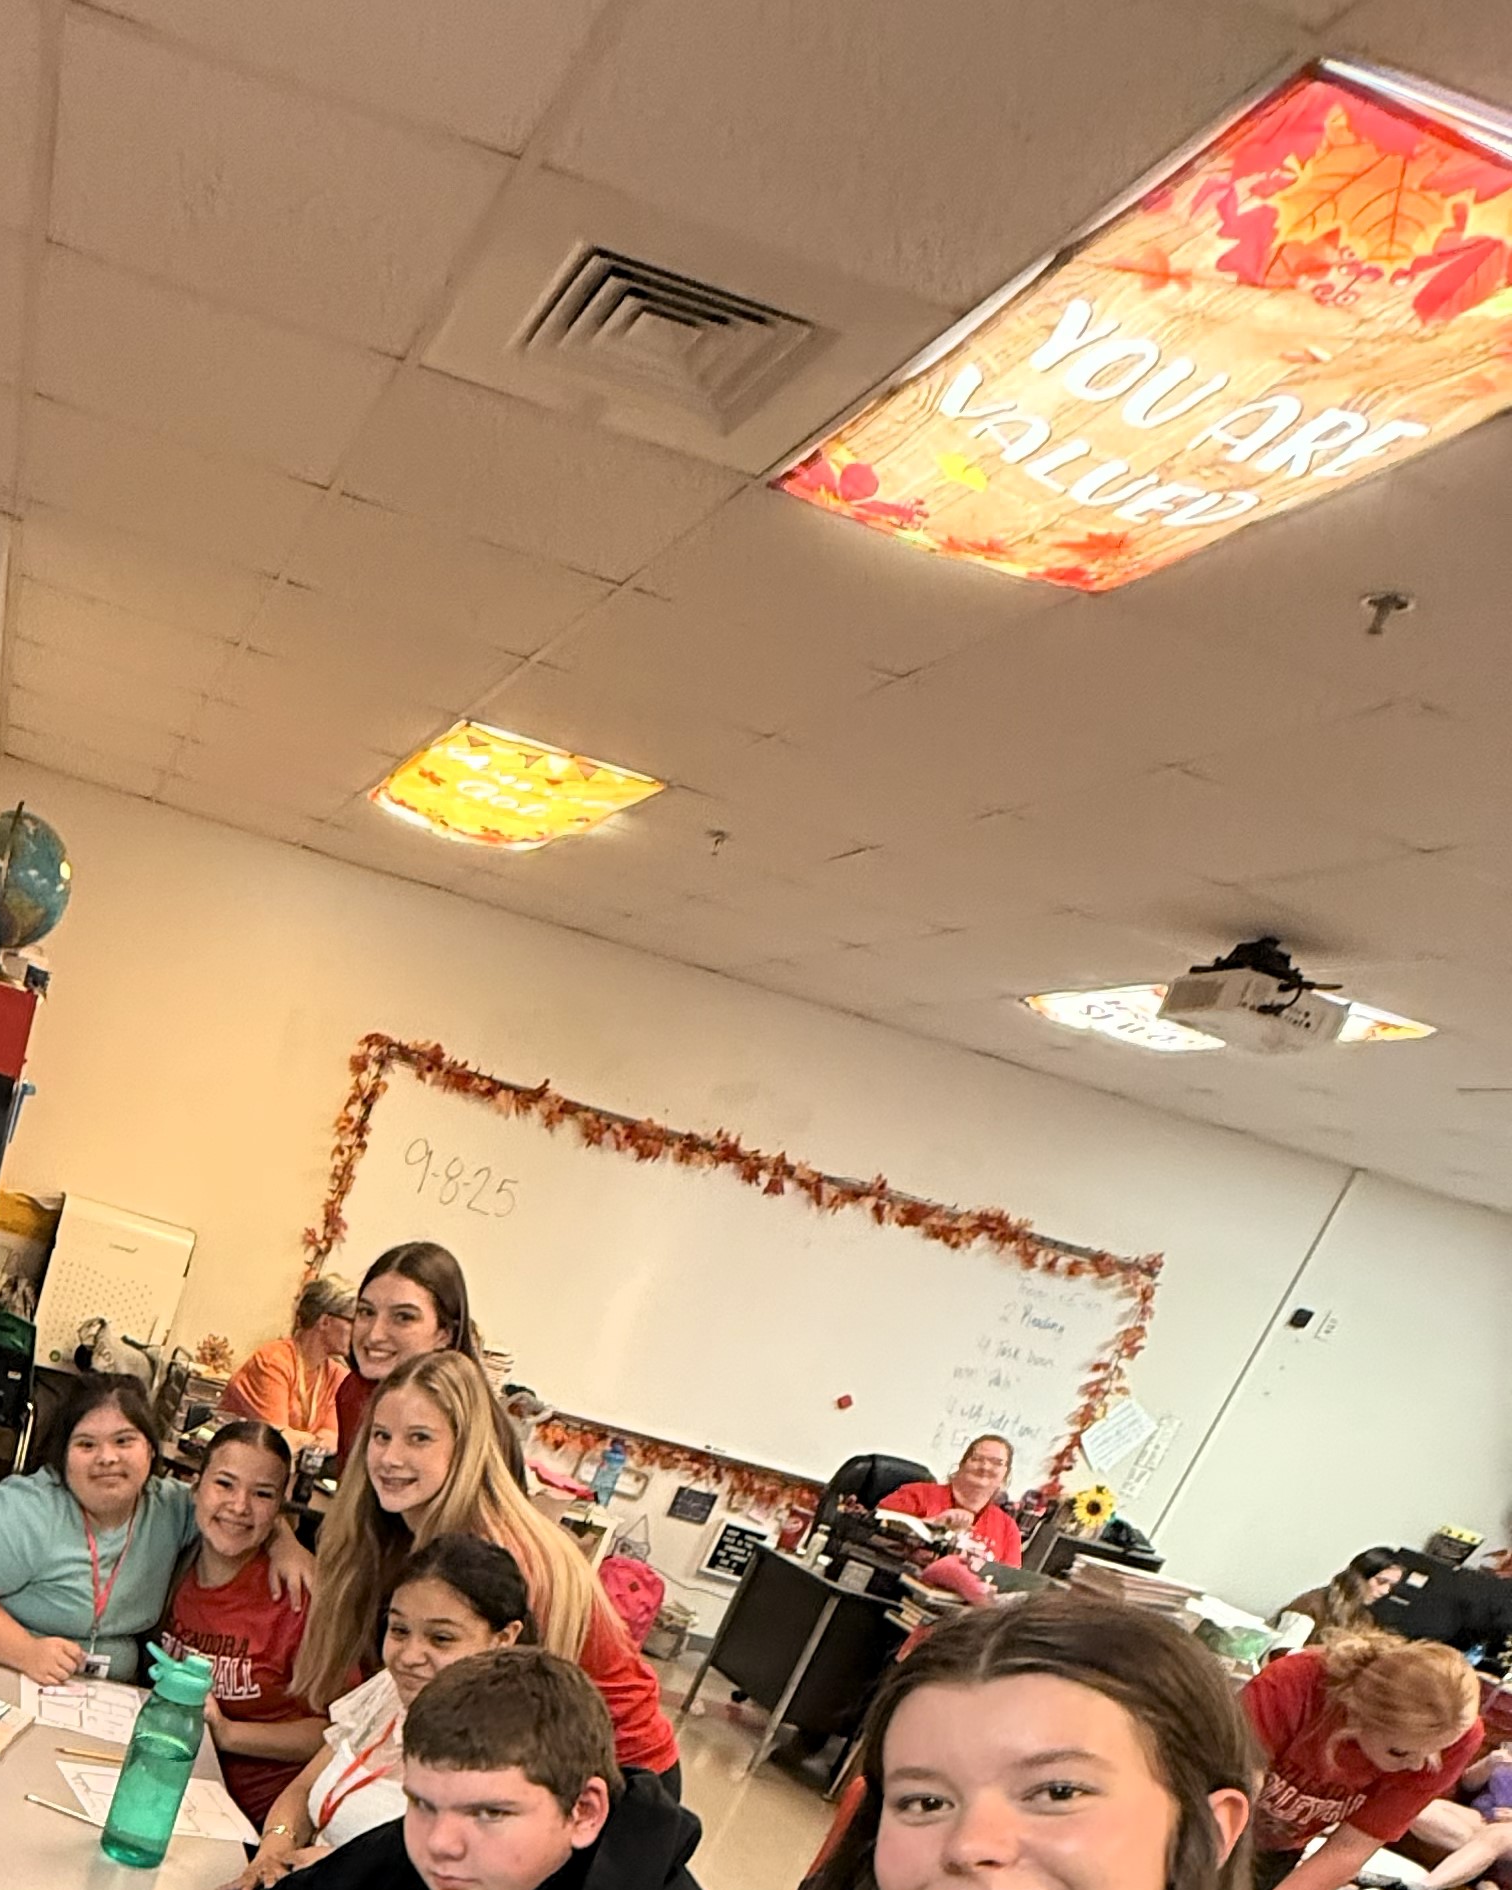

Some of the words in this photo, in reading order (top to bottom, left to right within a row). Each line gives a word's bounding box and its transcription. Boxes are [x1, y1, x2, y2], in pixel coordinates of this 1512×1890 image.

[938, 363, 1261, 529] VALUED
[1031, 299, 1226, 429] YOU
[1189, 393, 1432, 479] ARE
[404, 1138, 519, 1218] 9-8-25
